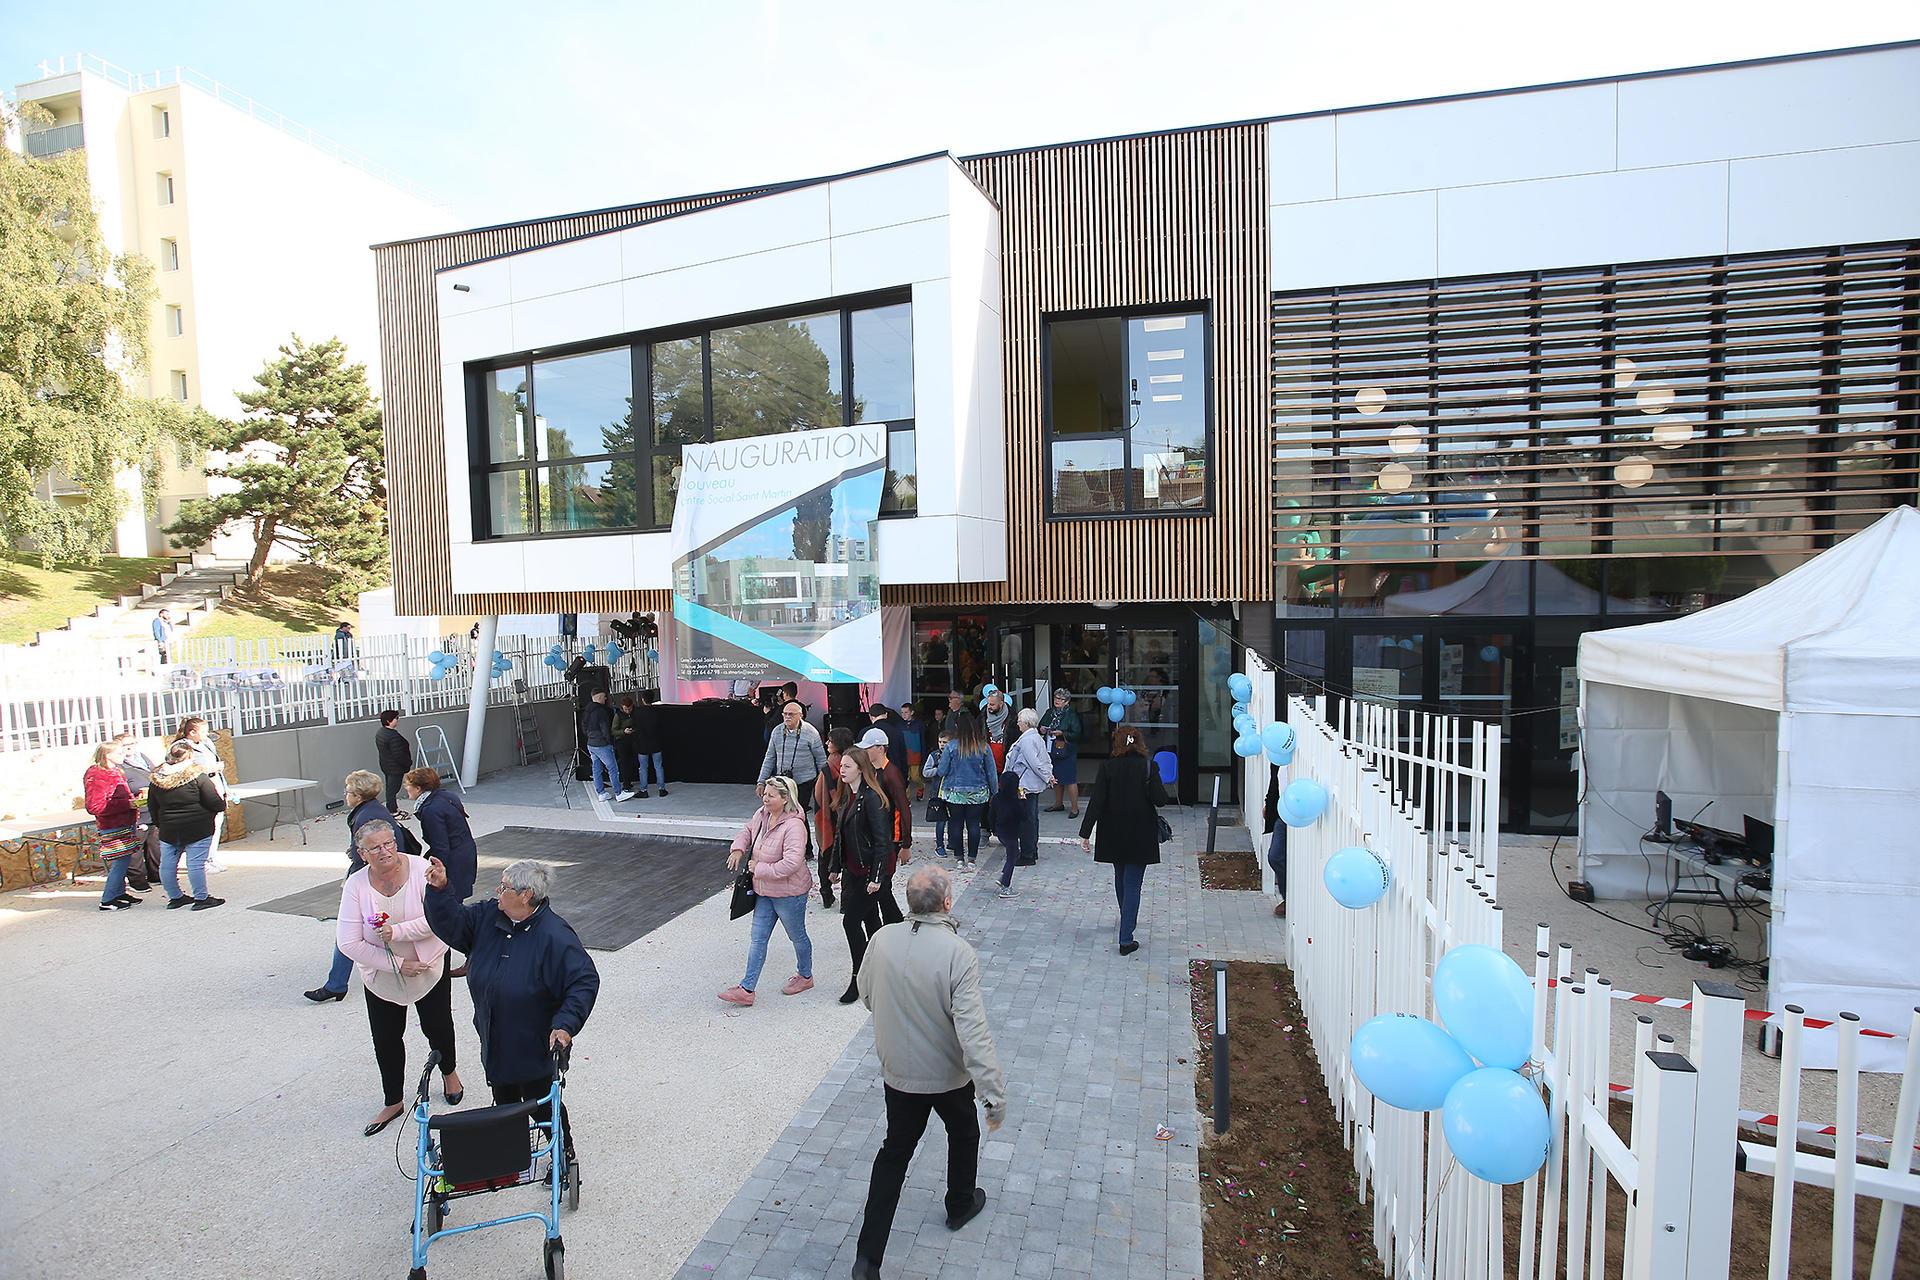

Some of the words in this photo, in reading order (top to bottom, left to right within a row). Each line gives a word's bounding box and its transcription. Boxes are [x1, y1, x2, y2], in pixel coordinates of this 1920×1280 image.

[708, 494, 733, 504] Social
[737, 491, 760, 502] Saint
[762, 488, 792, 499] Martin
